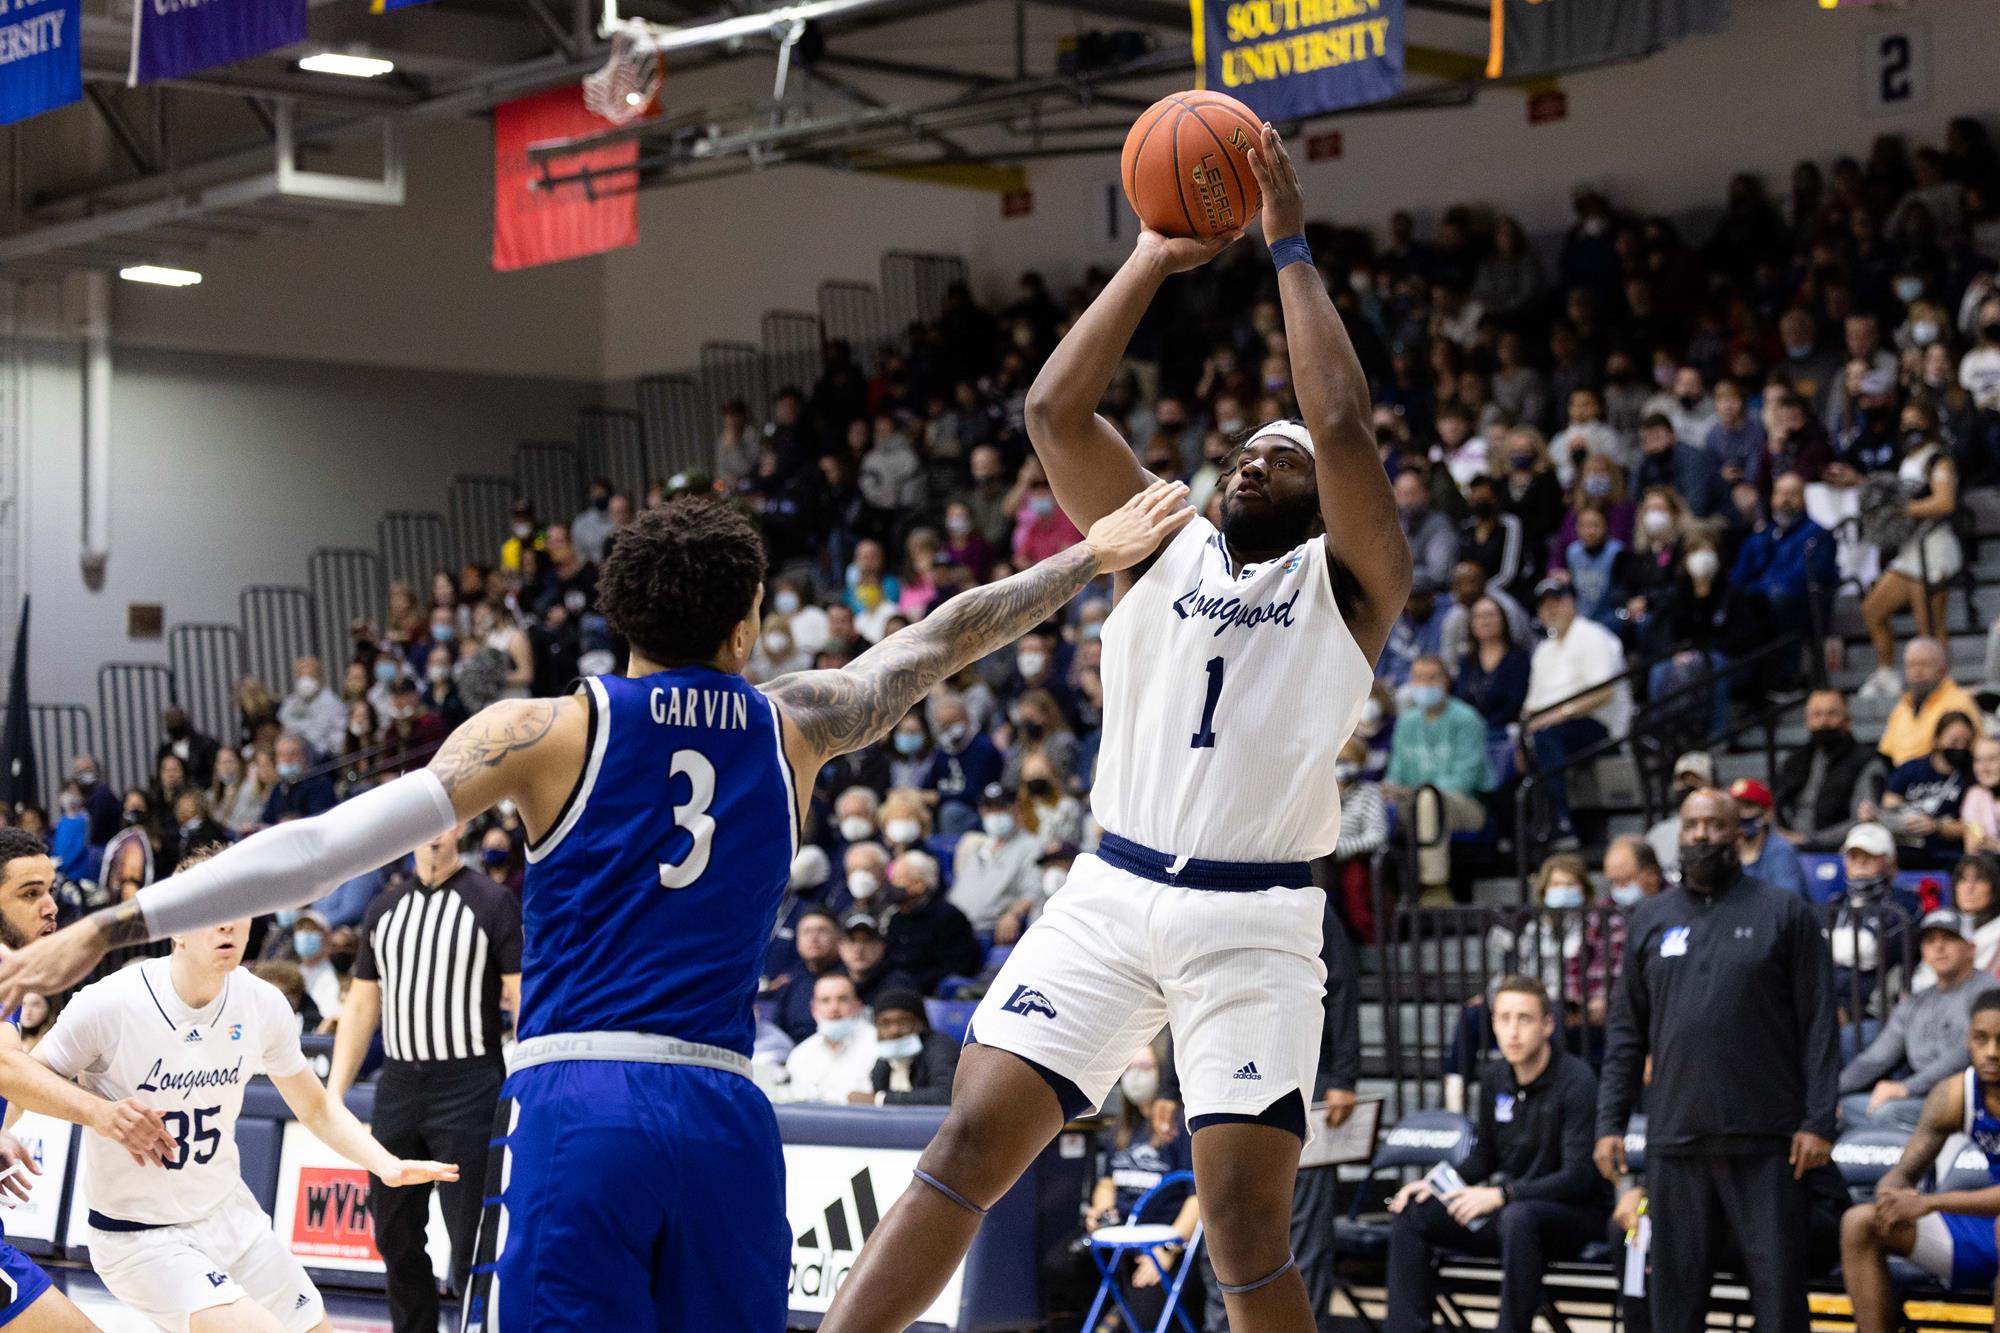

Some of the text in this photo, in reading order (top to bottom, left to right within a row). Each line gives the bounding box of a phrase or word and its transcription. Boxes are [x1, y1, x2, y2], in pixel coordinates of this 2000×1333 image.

[1221, 16, 1389, 88] UNIVERSITY
[1880, 34, 1910, 101] 2
[1173, 579, 1300, 637] Longwood
[650, 687, 747, 731] GARVIN
[1190, 655, 1224, 749] 1
[658, 749, 716, 889] 3
[137, 1055, 243, 1100] Longwood
[1233, 1072, 1262, 1081] adidas
